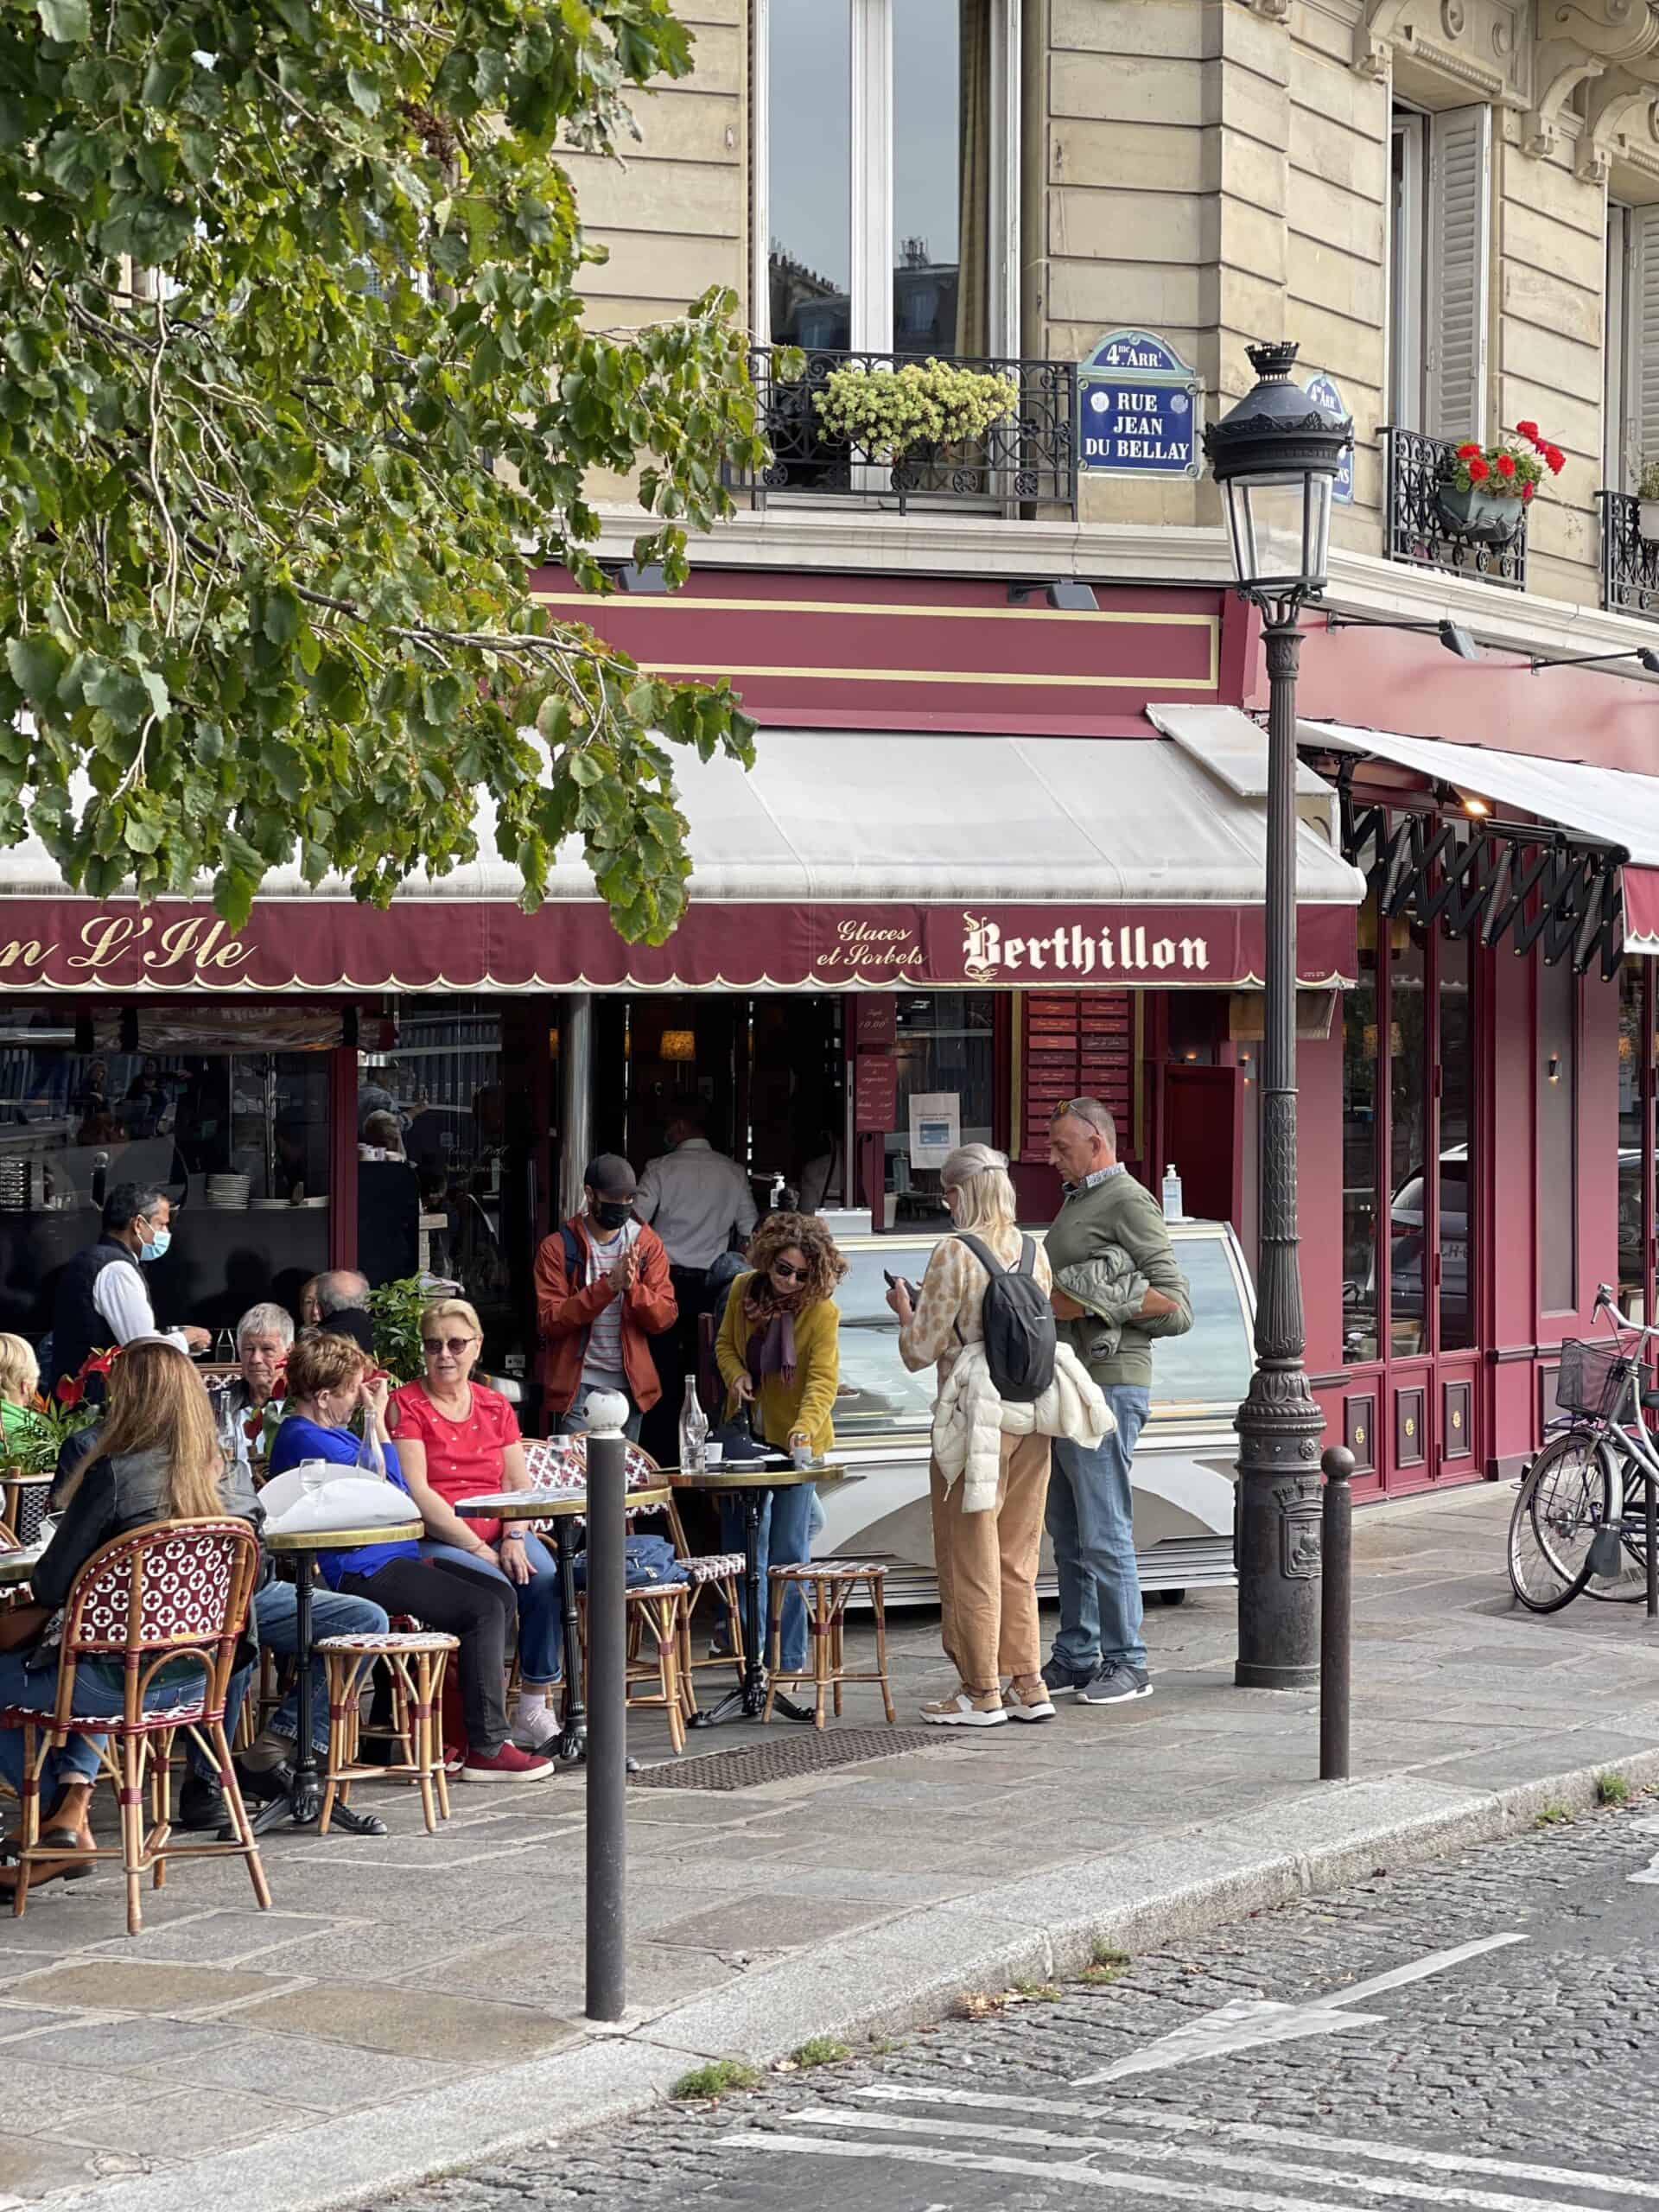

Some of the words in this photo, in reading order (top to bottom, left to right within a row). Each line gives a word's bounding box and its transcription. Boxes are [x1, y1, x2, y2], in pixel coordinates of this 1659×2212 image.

[1117, 392, 1158, 412] RUE
[1113, 416, 1163, 435] JEAN
[1085, 438, 1110, 456] DU
[1116, 440, 1190, 460] BELLAY
[836, 919, 912, 941] Glaces
[0, 940, 60, 967] n
[817, 946, 842, 966] et
[843, 944, 926, 965] Sorbets
[963, 912, 1210, 982] Berthillon
